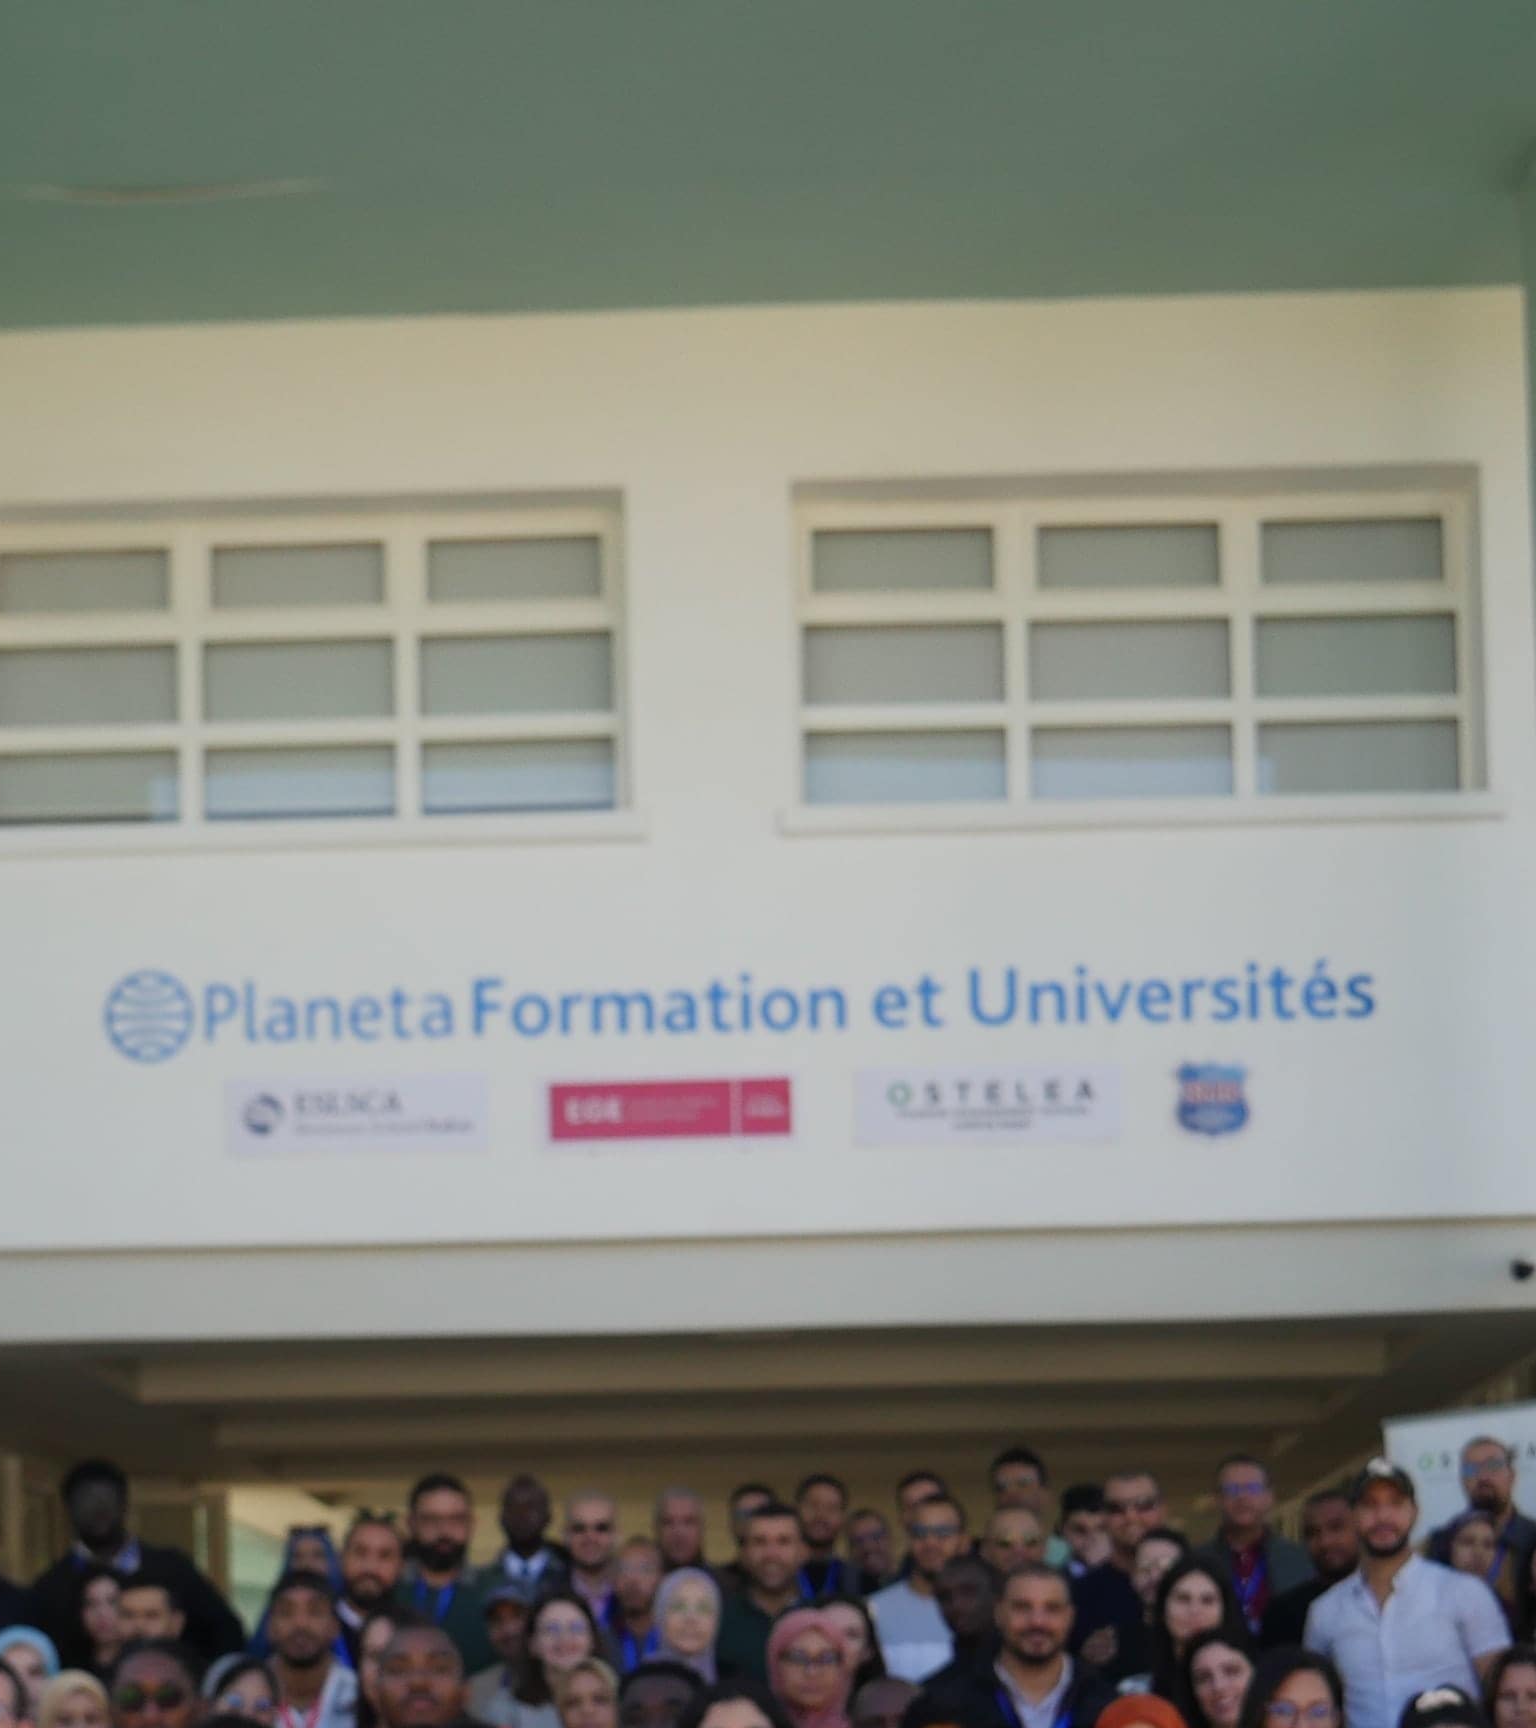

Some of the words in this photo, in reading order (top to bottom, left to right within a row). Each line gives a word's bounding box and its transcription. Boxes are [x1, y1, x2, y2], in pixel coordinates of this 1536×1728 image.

[202, 982, 454, 1043] Planeta
[471, 974, 850, 1037] Formation
[871, 974, 942, 1029] et
[968, 958, 1377, 1027] Universités
